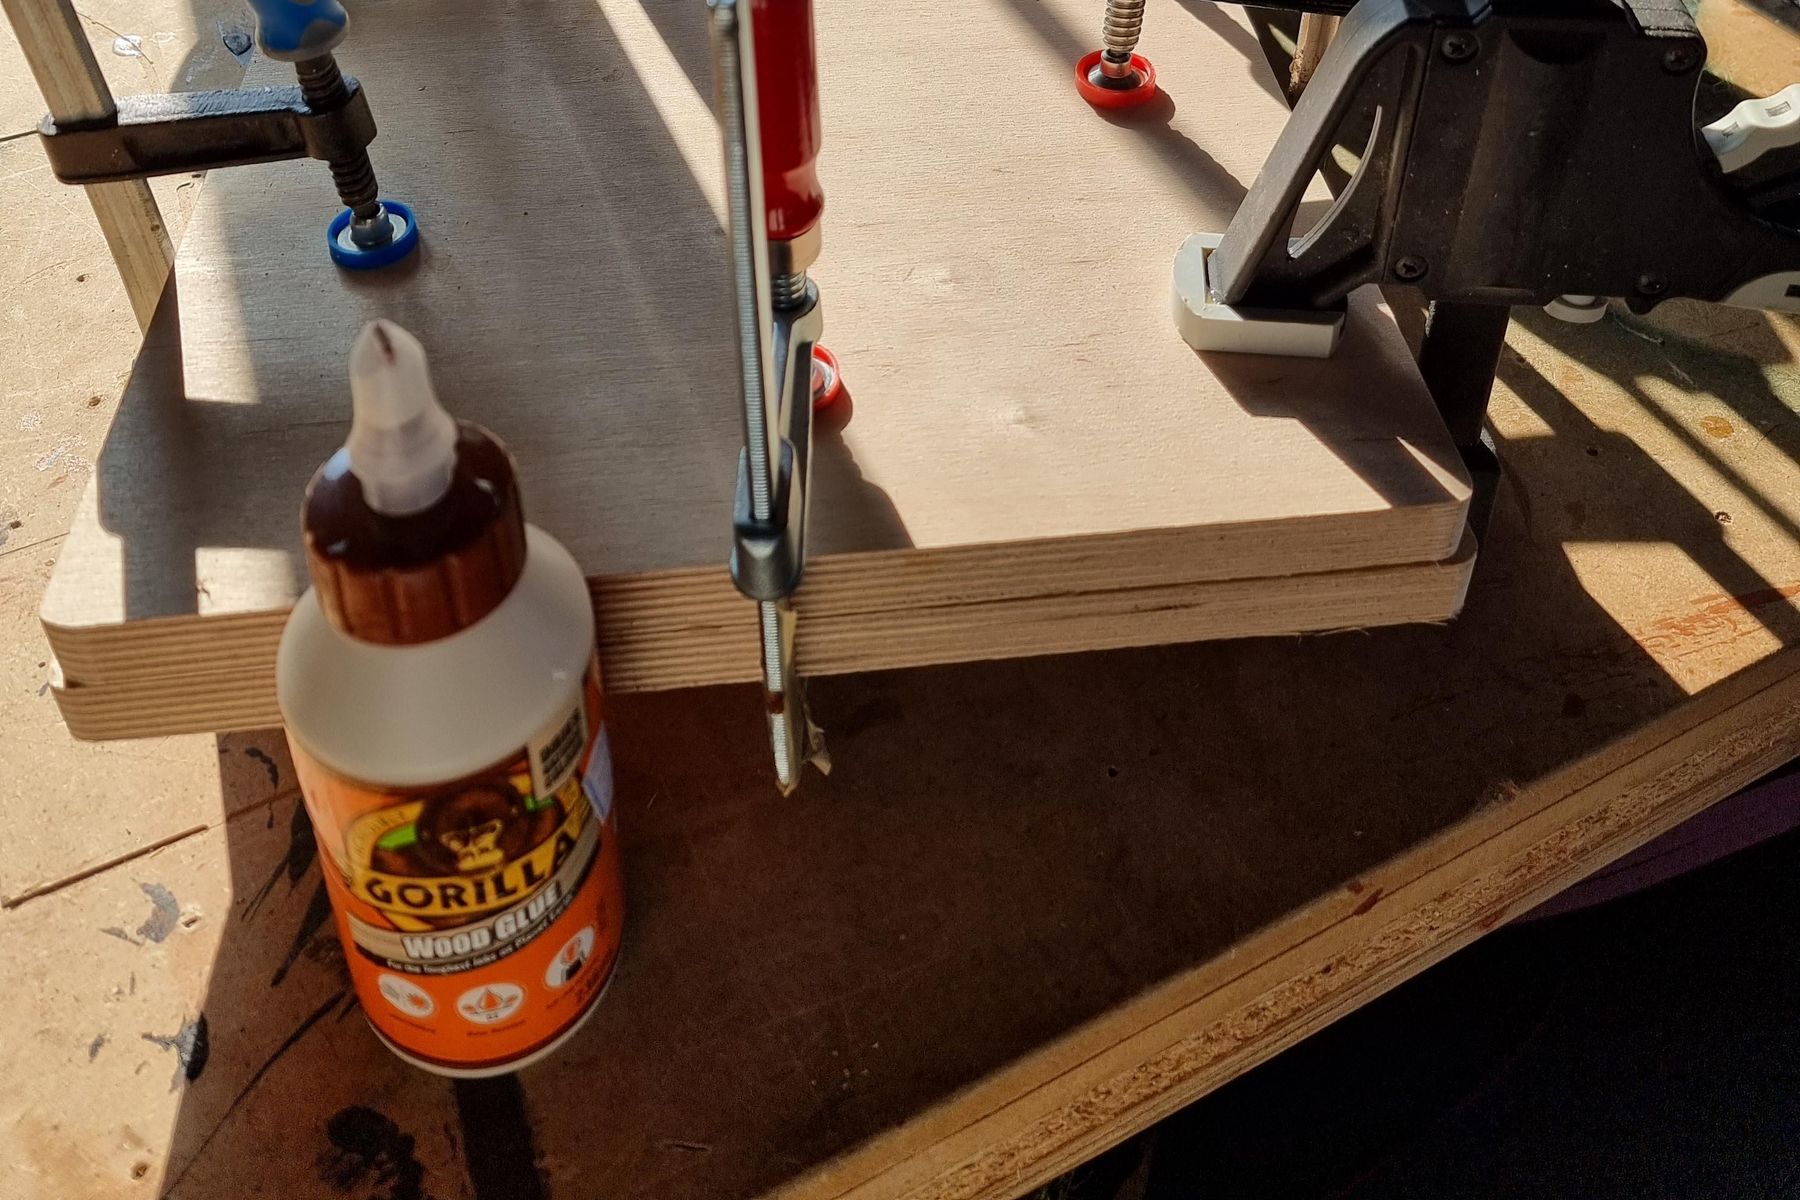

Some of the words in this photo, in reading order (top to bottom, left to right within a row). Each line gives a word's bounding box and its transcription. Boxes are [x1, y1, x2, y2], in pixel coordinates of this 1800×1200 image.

[365, 831, 573, 909] GORILLA
[402, 927, 491, 960] WOOD
[494, 881, 559, 941] GLUE
